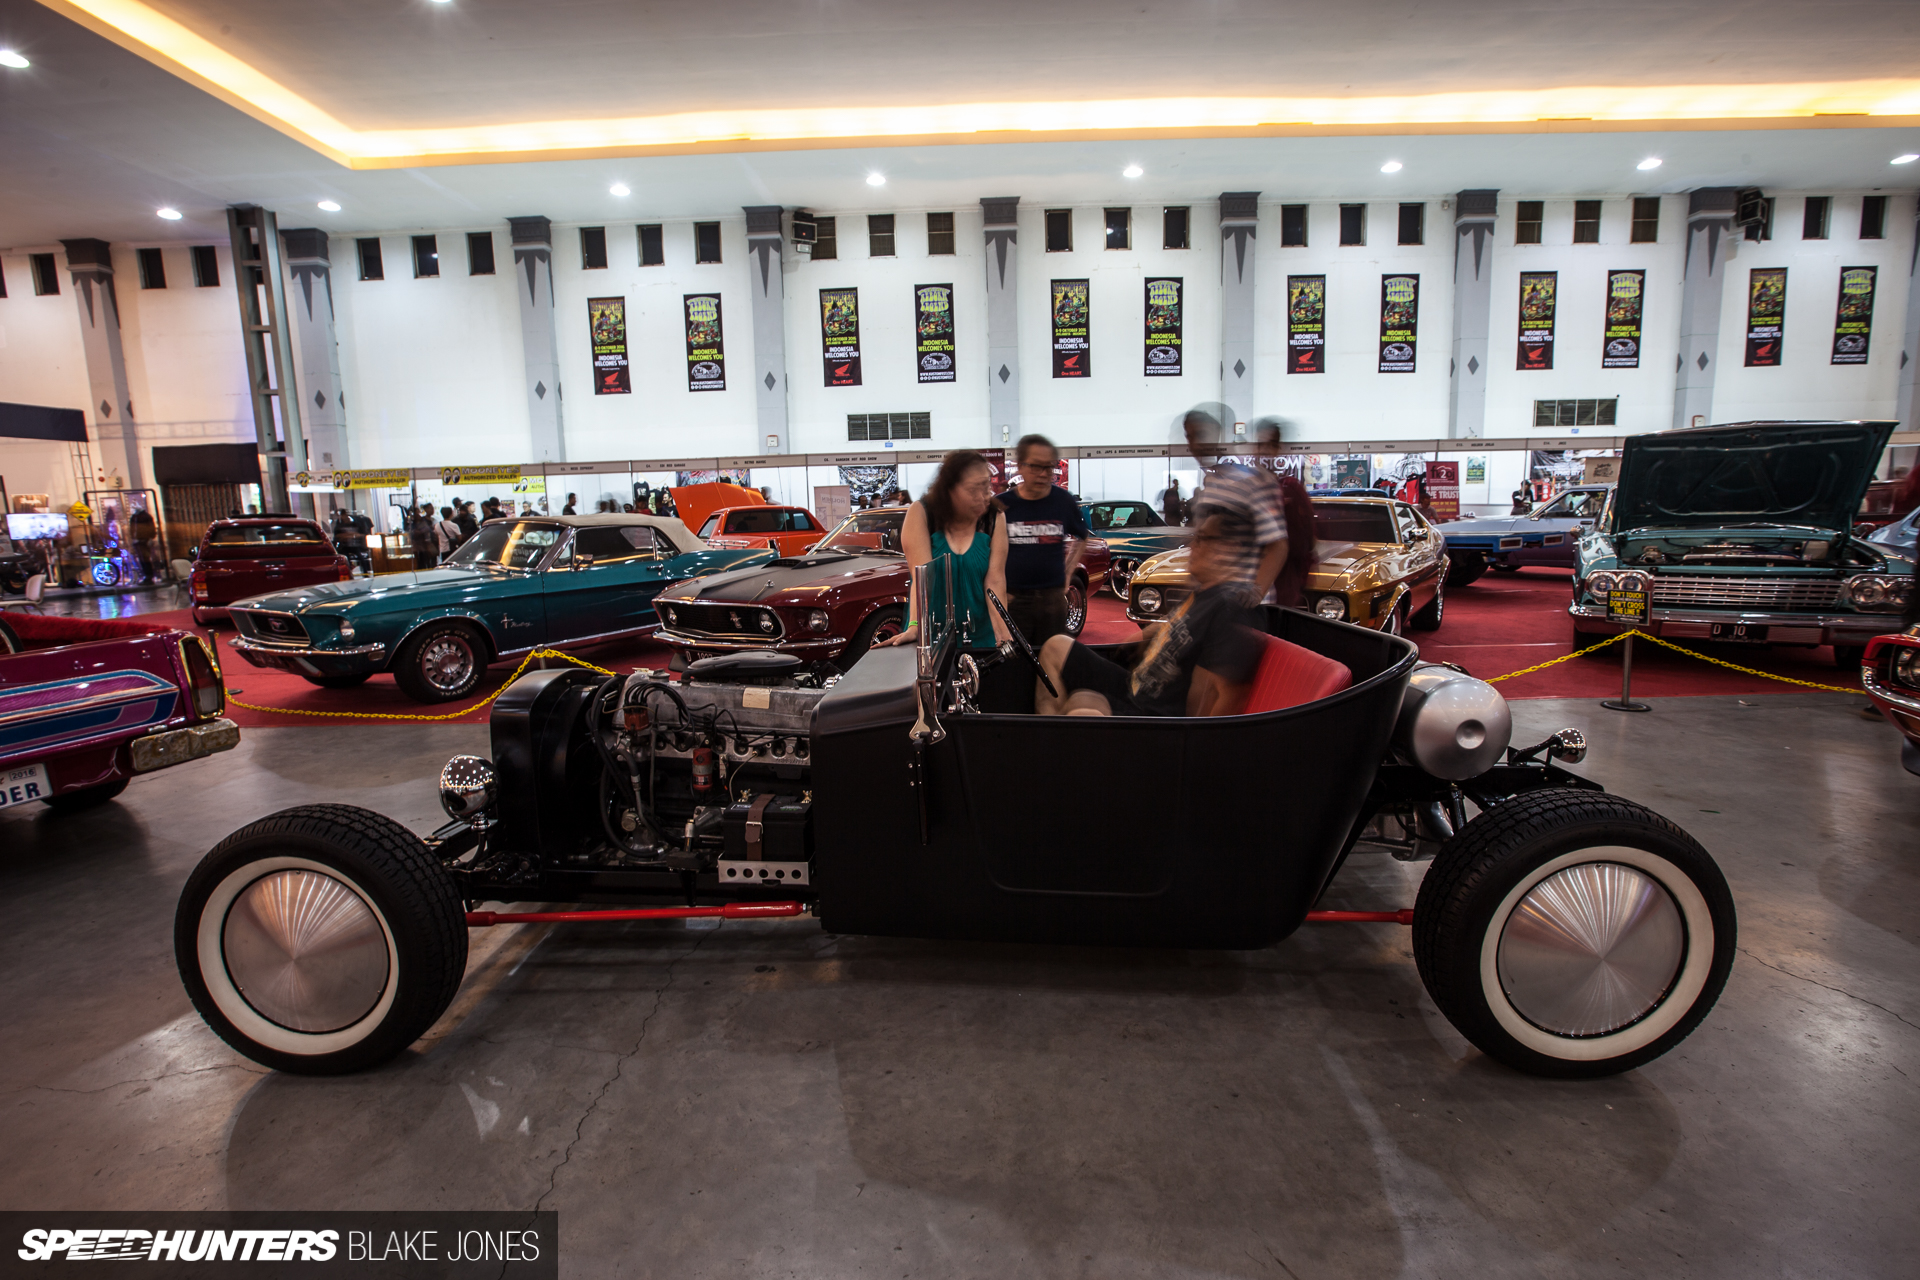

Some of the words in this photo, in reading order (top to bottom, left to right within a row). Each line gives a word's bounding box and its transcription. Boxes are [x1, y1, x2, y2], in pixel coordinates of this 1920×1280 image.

[352, 468, 408, 478] MOONEYES
[461, 465, 520, 476] MOONEYES
[1439, 490, 1459, 499] TRUST
[1713, 624, 1721, 634] D
[1733, 625, 1746, 636] 10
[12, 769, 34, 779] 2016
